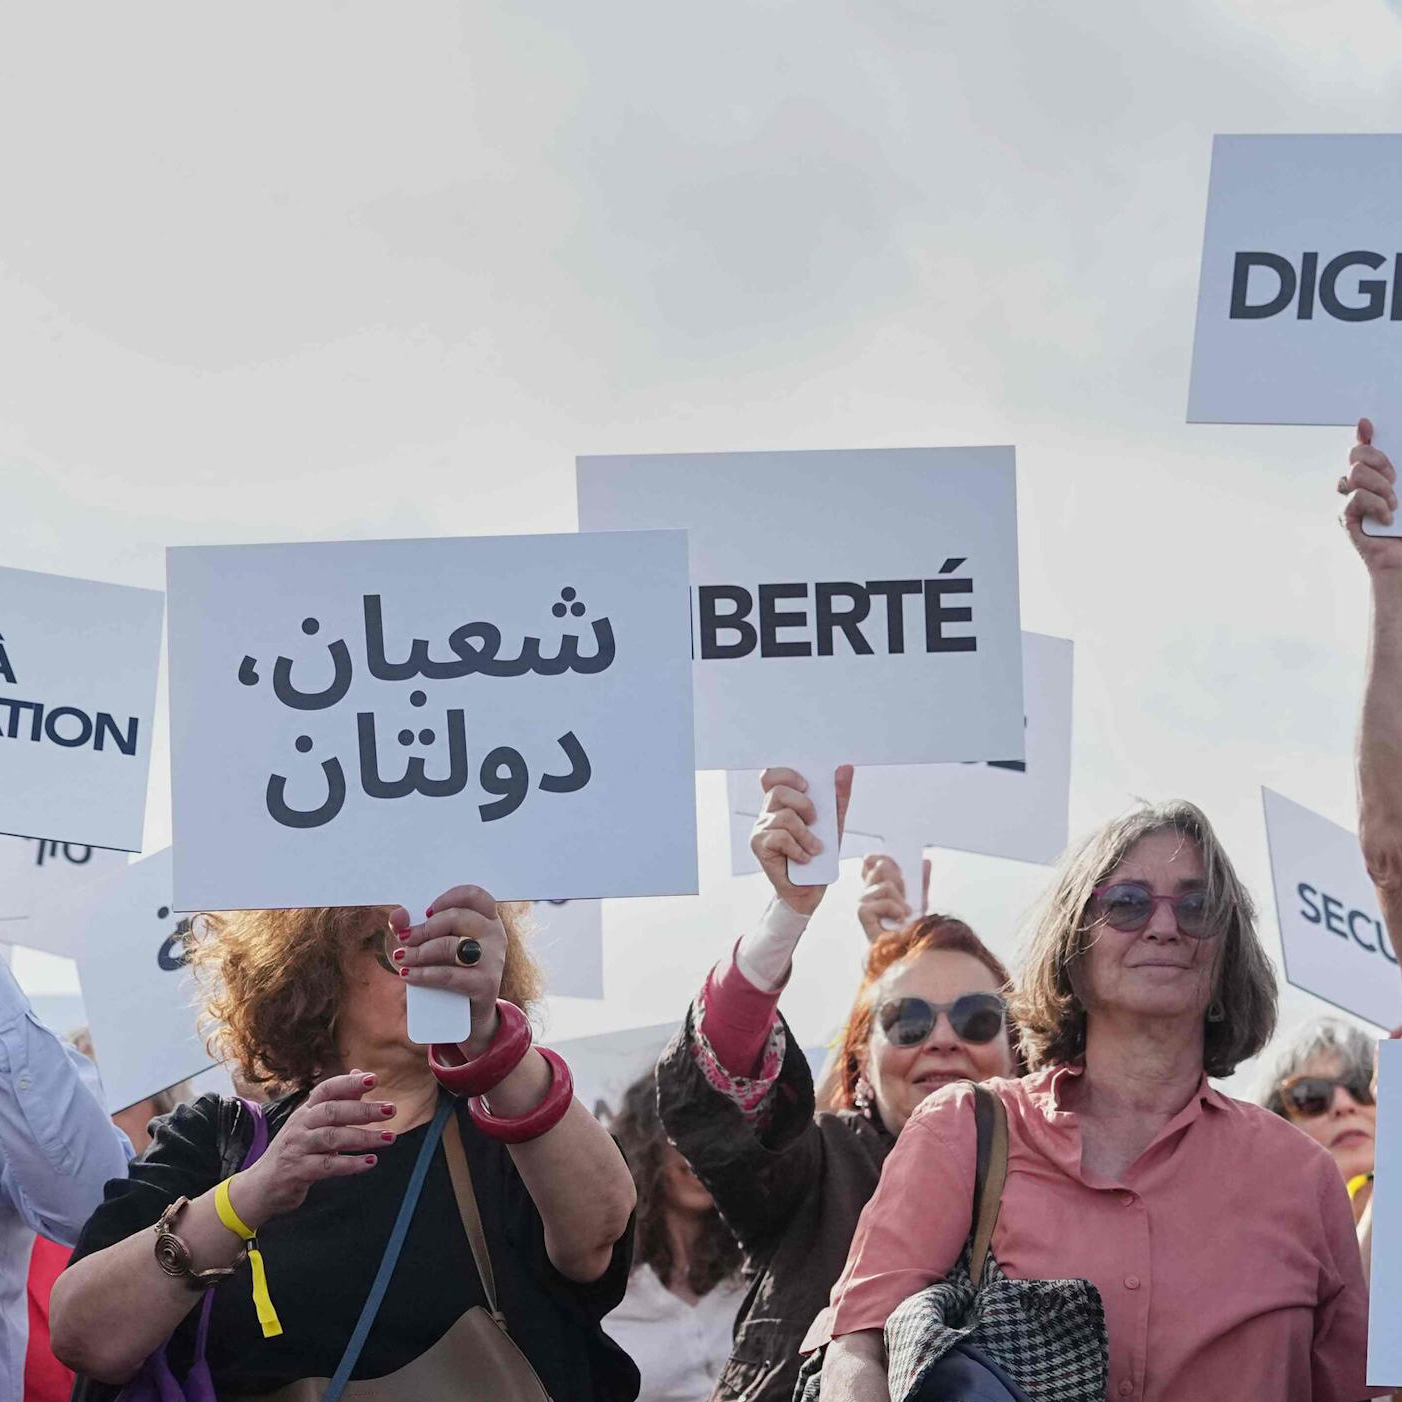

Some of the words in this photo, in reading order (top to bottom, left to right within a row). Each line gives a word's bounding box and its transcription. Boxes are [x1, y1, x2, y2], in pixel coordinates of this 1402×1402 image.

[238, 586, 616, 711] شعبان،
[690, 557, 978, 661] BERTÉ
[265, 708, 593, 830] دولتان
[1297, 882, 1401, 965] SECU
